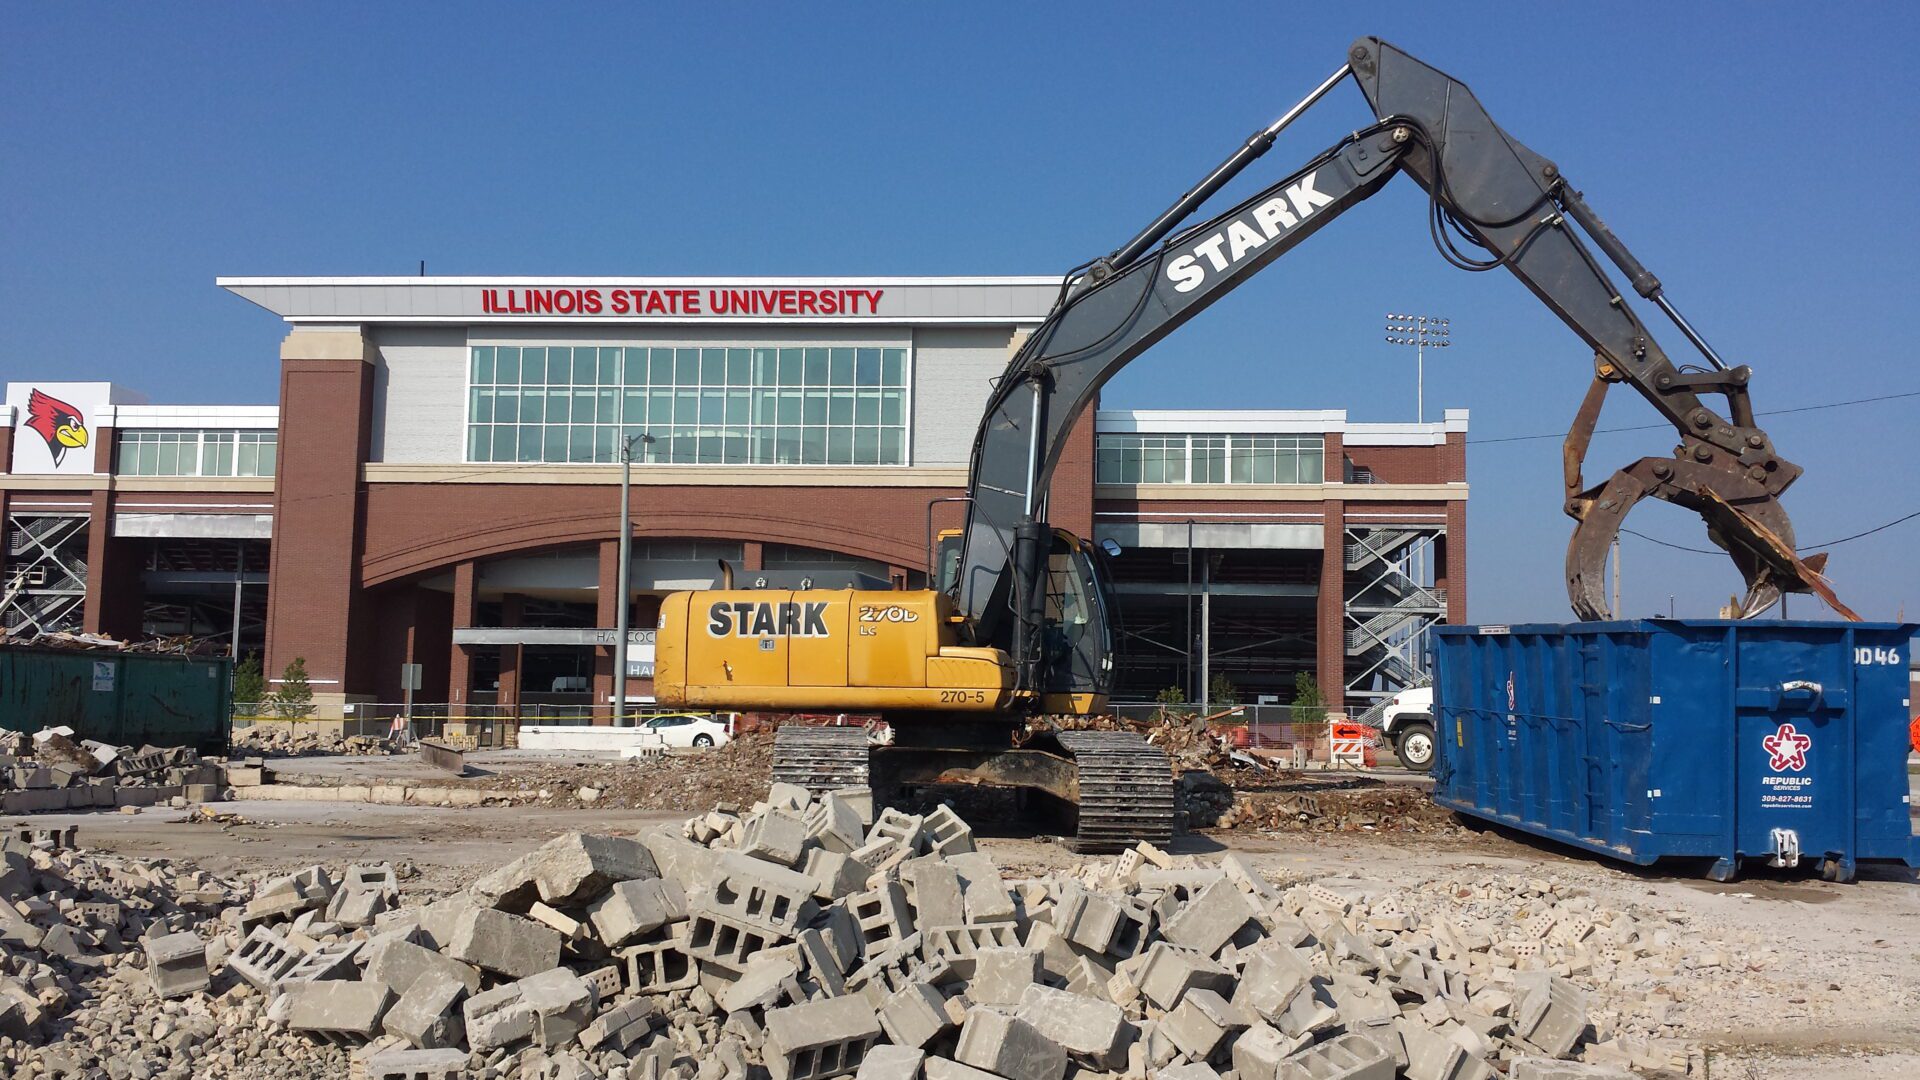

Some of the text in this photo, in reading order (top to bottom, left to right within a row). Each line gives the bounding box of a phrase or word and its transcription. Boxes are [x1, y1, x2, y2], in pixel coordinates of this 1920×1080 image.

[1166, 170, 1335, 293] STARK
[482, 289, 883, 314] ILLINOIS STATE UNIVERSITY
[708, 601, 829, 636] STARK
[859, 605, 918, 622] 270D
[941, 690, 985, 703] 270-5
[1762, 776, 1812, 785] REPUBLIC
